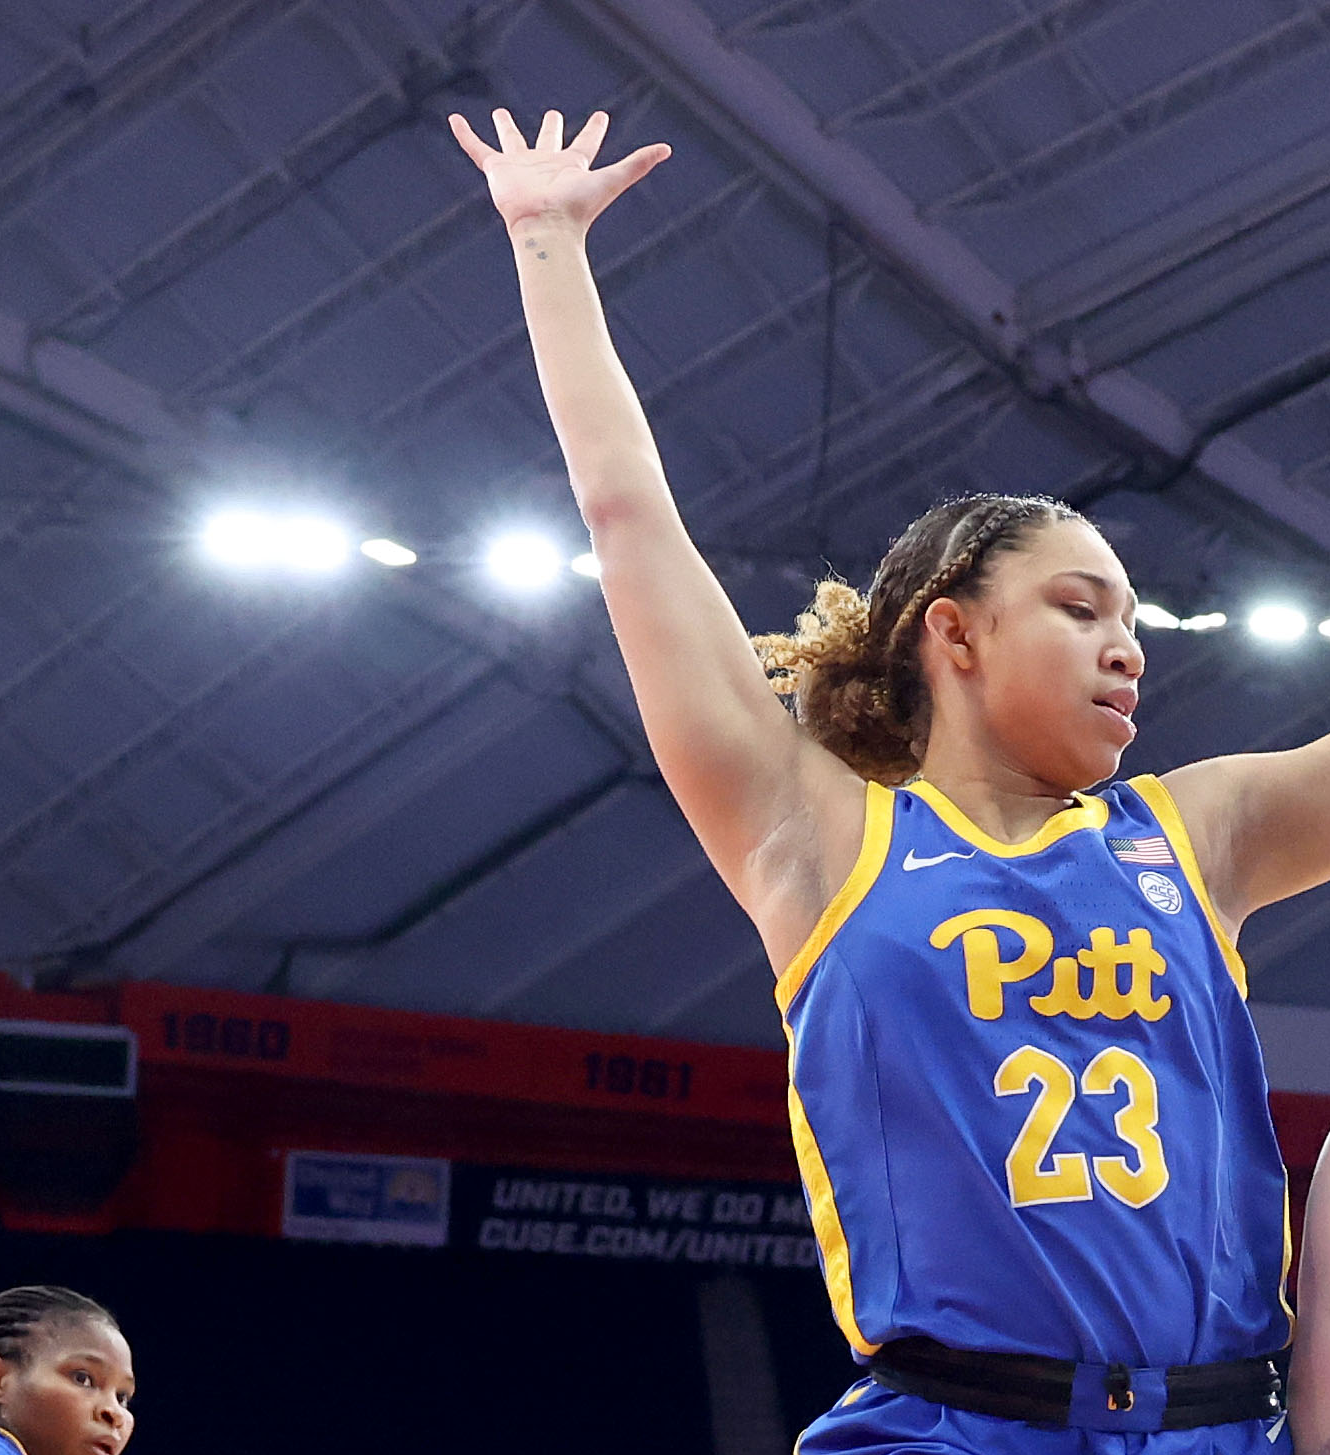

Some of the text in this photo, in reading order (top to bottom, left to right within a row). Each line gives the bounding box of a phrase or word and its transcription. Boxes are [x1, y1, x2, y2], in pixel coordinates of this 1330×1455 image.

[1146, 884, 1176, 900] ACC
[929, 908, 1172, 1022] Pitt
[993, 1043, 1170, 1210] 23
[491, 1177, 637, 1218] UNITED,
[644, 1184, 706, 1221] WE
